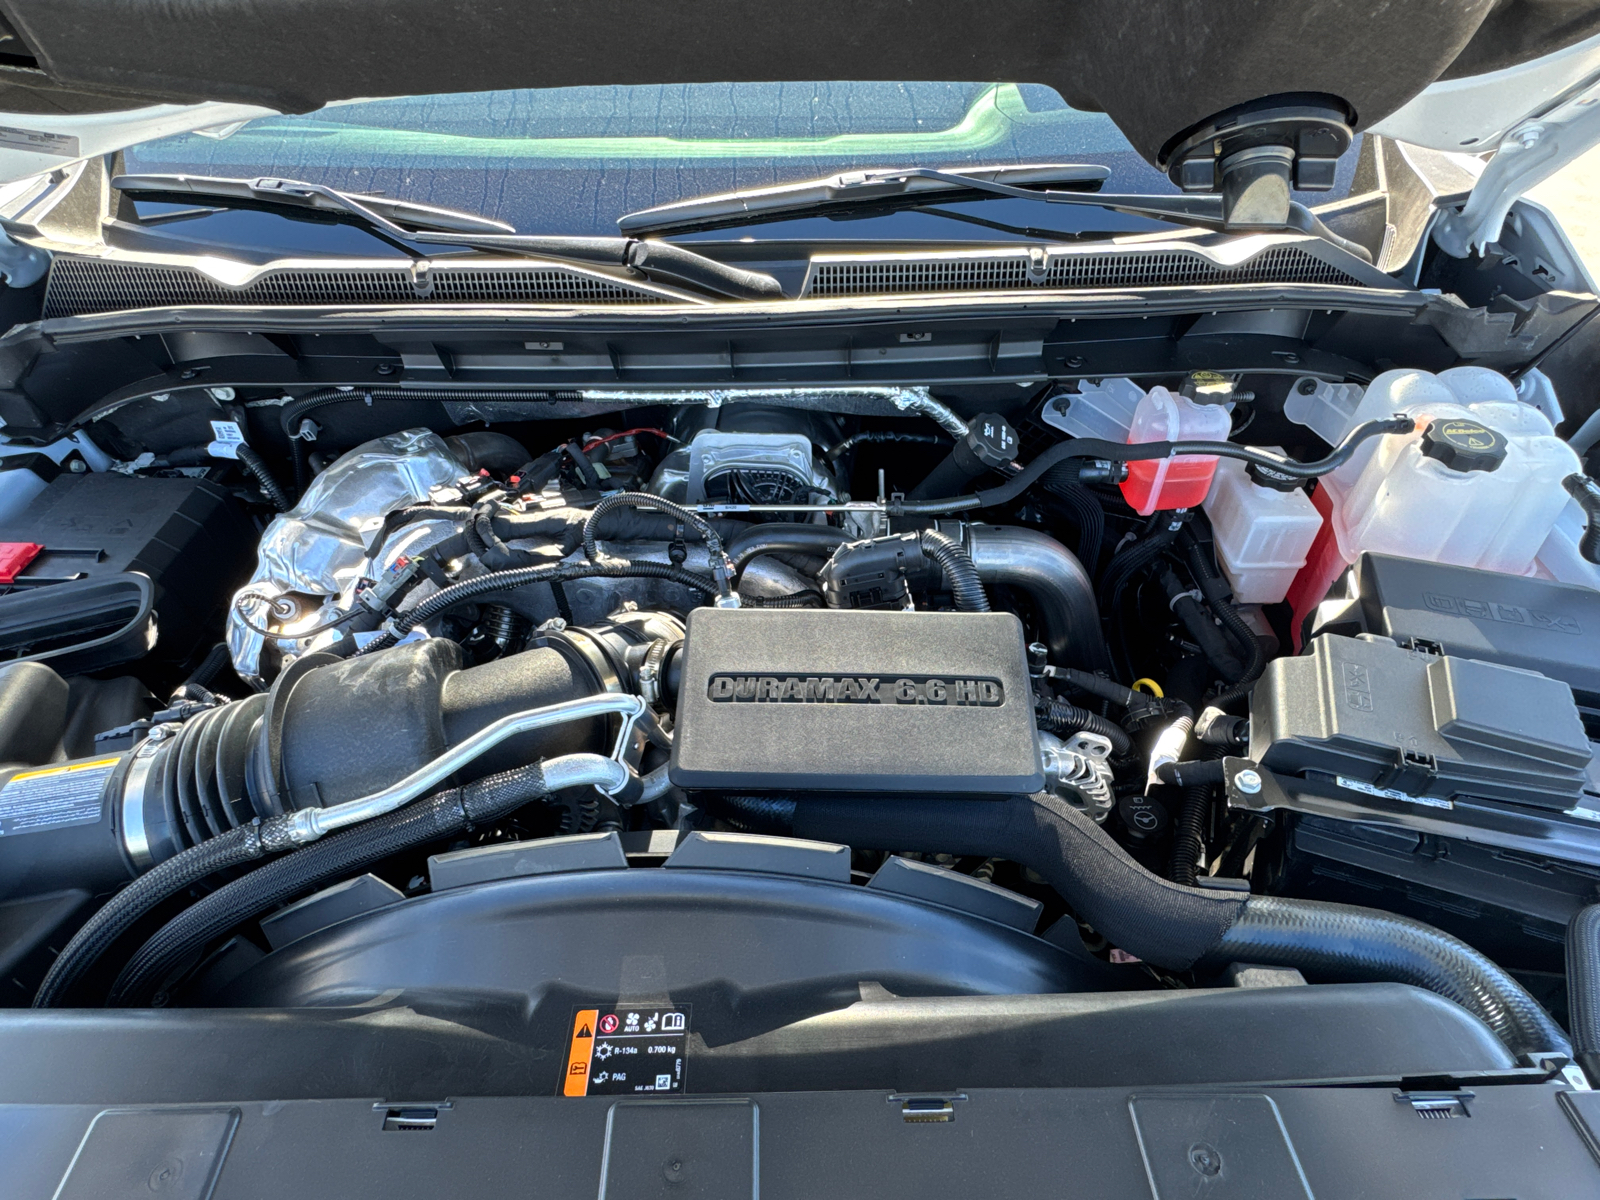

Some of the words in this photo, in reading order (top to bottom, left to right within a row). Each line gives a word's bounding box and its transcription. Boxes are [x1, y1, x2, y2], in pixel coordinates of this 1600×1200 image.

[713, 676, 880, 701] DURAMAX
[895, 678, 947, 702] 6.6
[955, 680, 1000, 702] HD
[648, 1046, 666, 1054] 0.700
[667, 1046, 676, 1054] kg
[612, 1073, 626, 1081] PAG
